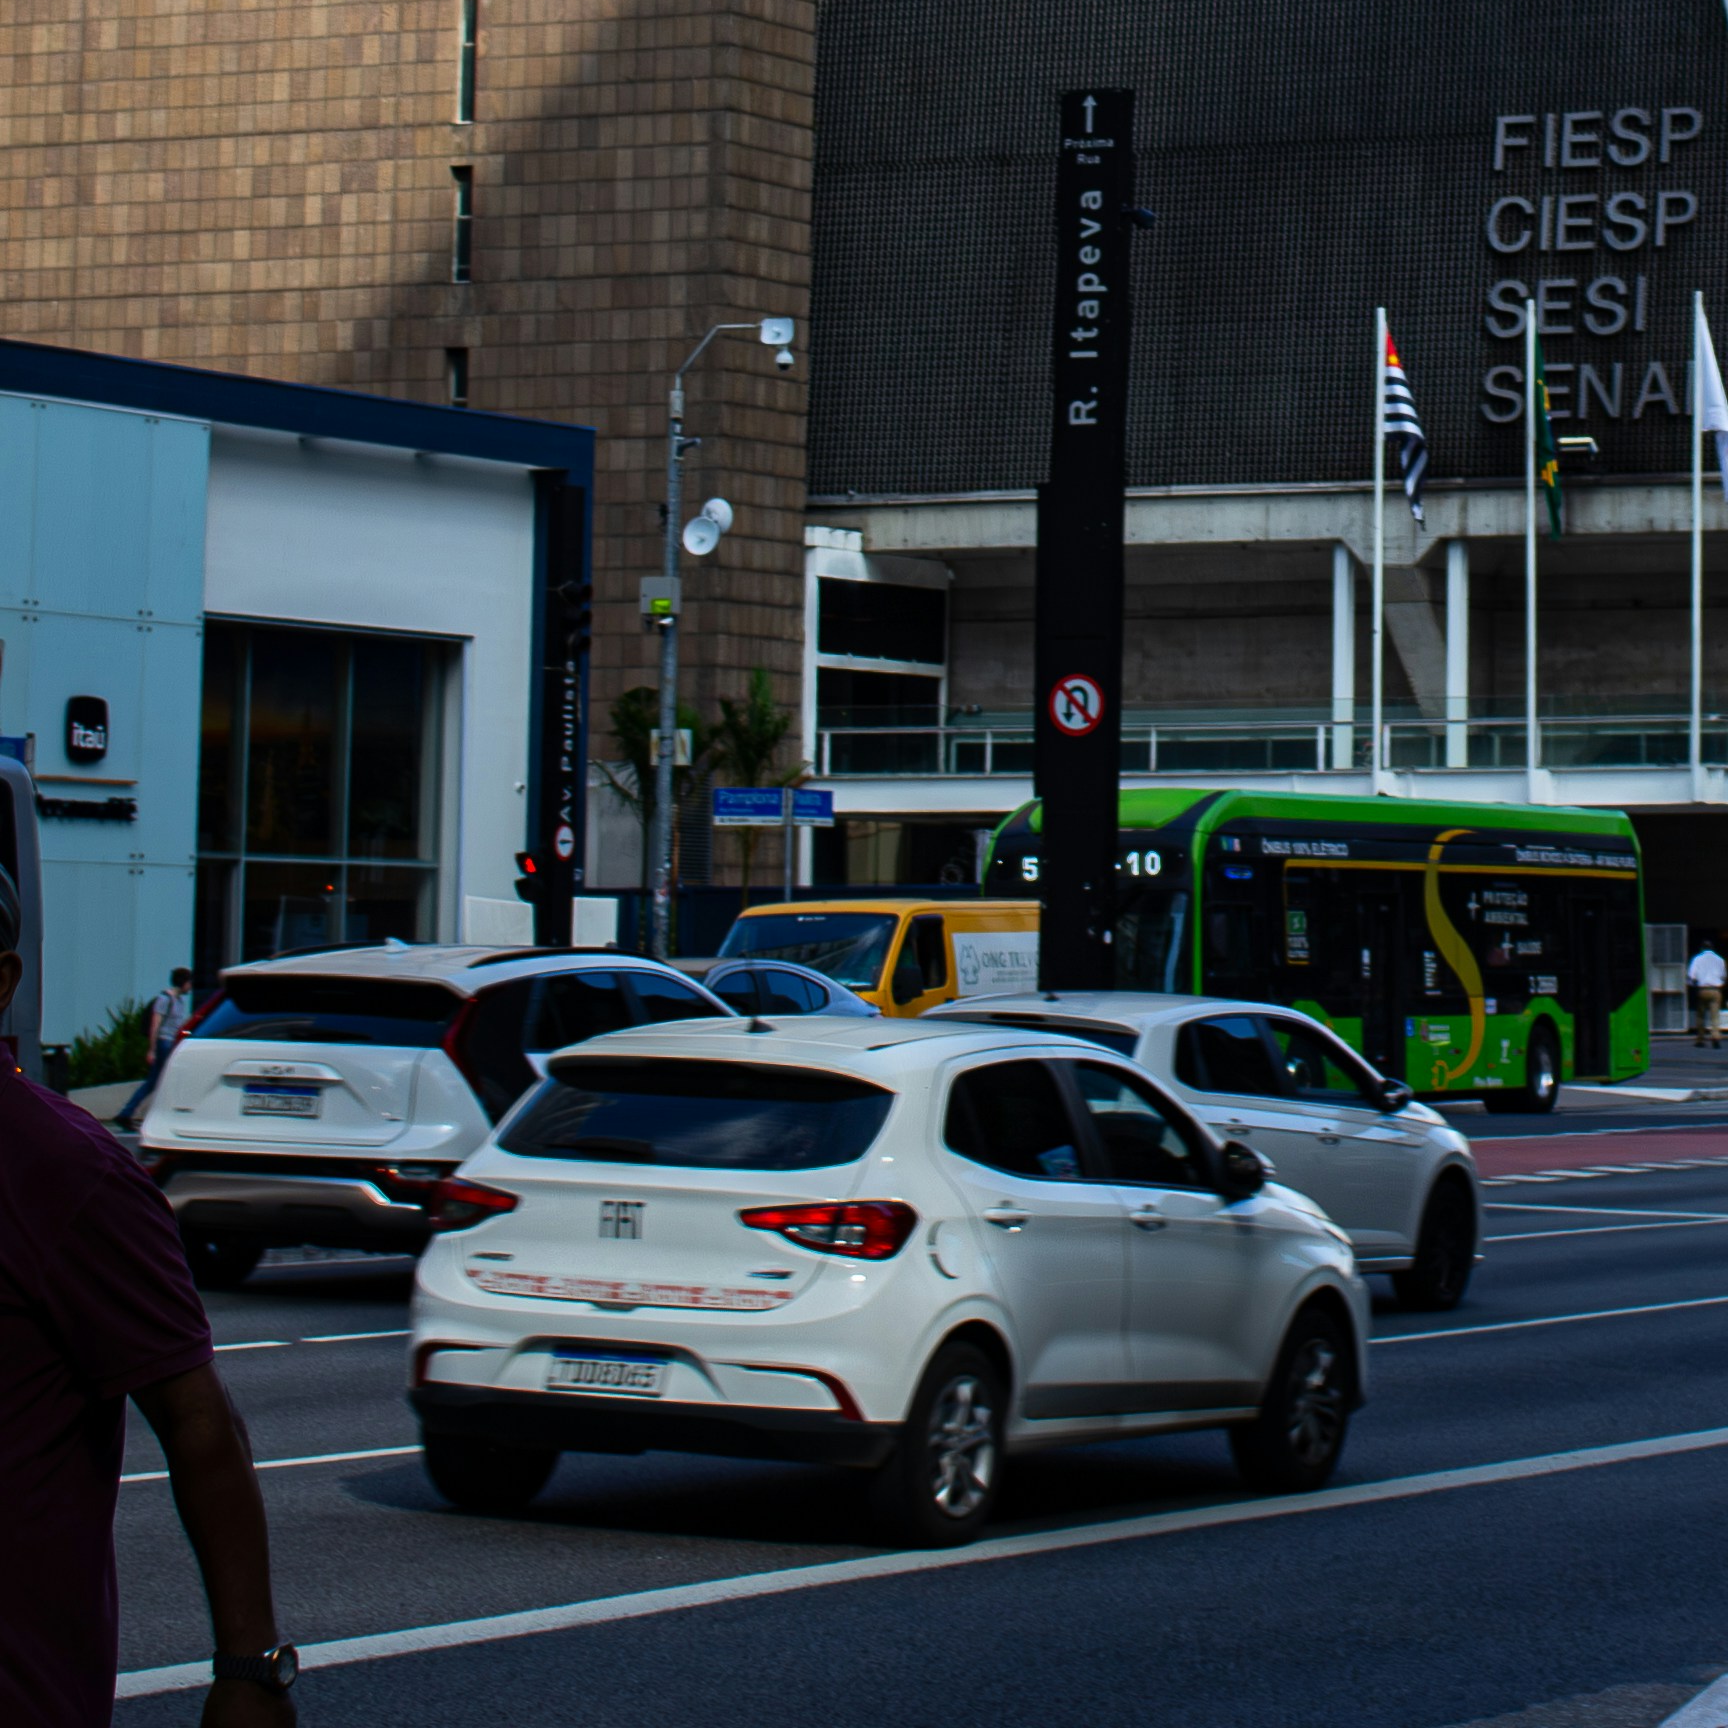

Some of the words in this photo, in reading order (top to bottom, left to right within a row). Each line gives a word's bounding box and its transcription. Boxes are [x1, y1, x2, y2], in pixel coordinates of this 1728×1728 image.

[1075, 153, 1102, 165] Rua
[1493, 107, 1703, 172] FIESP
[1487, 190, 1698, 254] CIESP
[1068, 189, 1109, 359] Itapeva
[1485, 275, 1648, 339] SESI
[1068, 384, 1101, 427] R.
[559, 658, 577, 773] Paulista
[1021, 854, 1040, 882] 5
